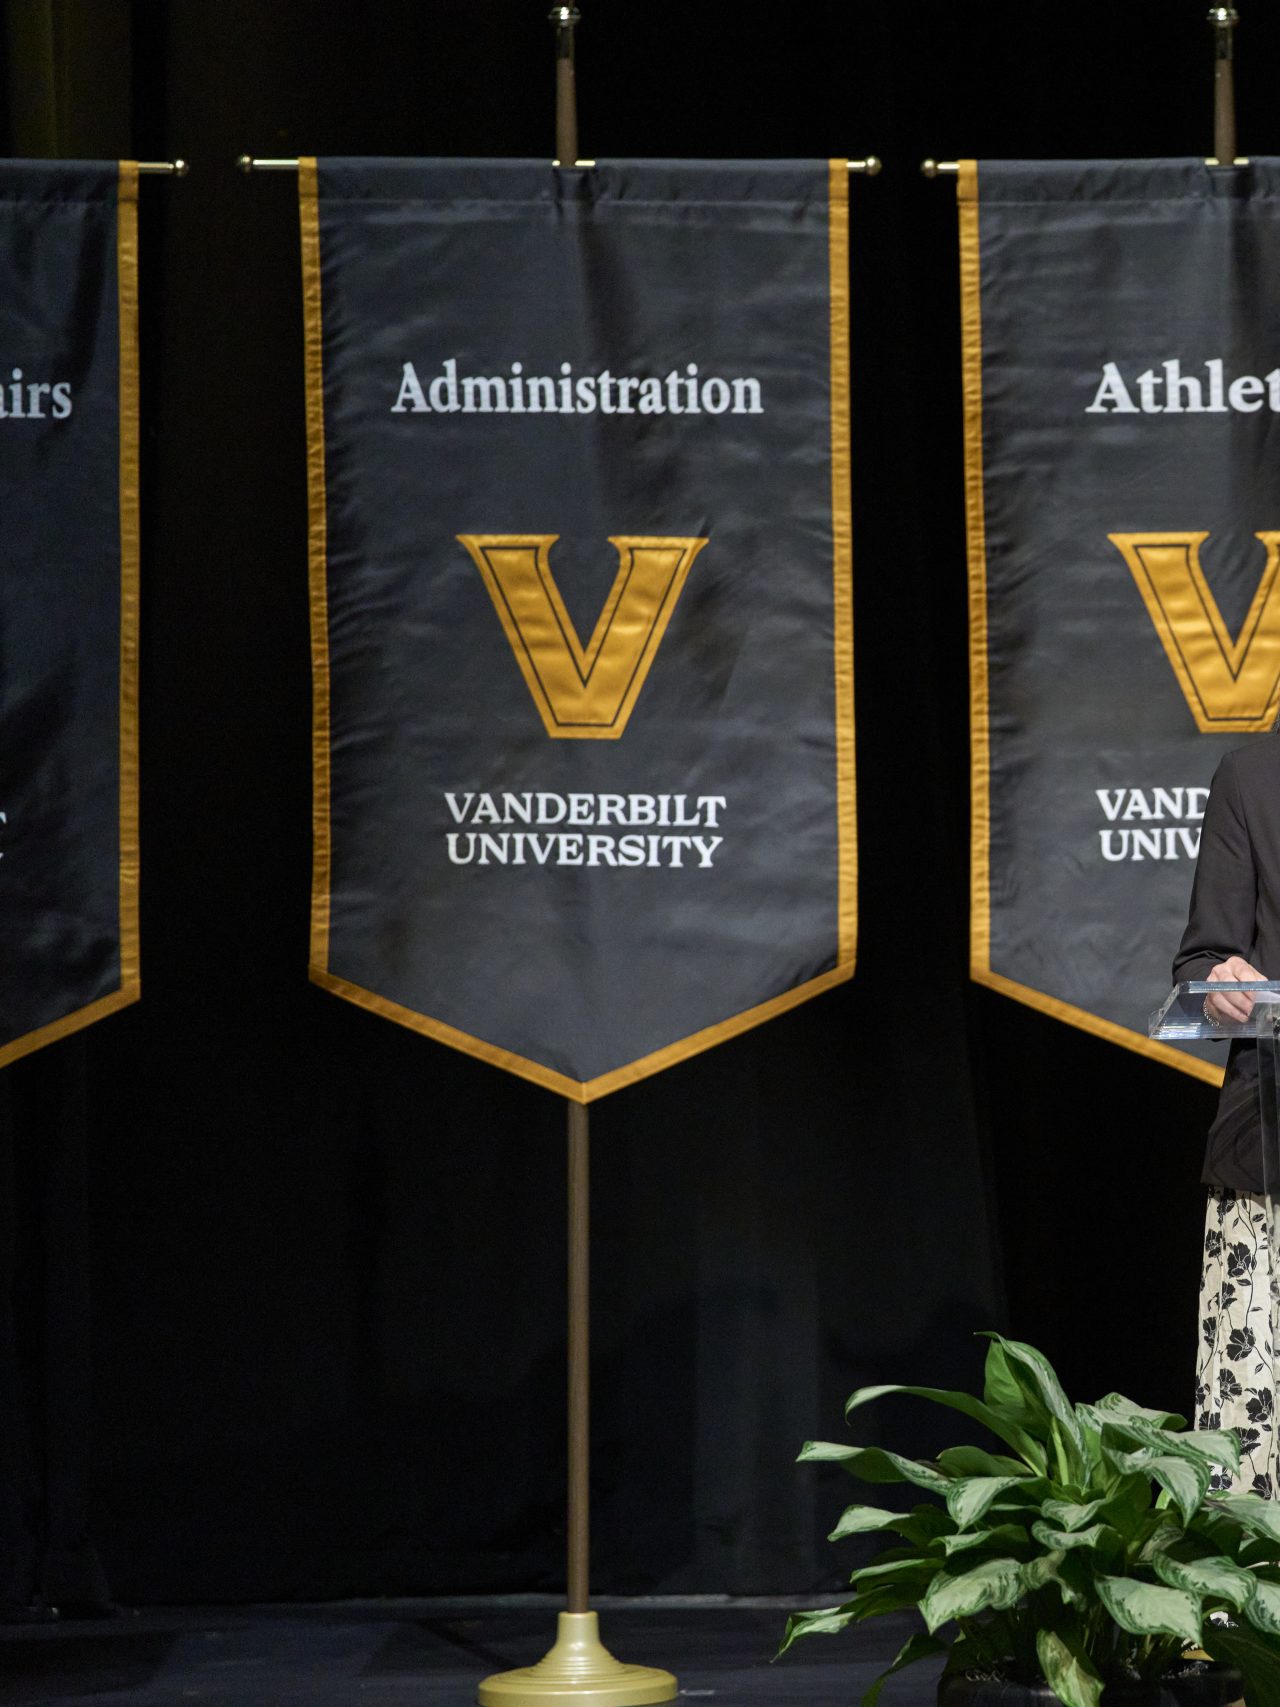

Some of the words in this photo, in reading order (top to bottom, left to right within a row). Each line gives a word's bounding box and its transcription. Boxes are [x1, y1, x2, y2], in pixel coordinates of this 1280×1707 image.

[390, 358, 765, 415] Administration
[456, 533, 710, 740] V
[444, 792, 727, 828] VANDERBILT
[446, 832, 724, 868] UNIVERSITY
